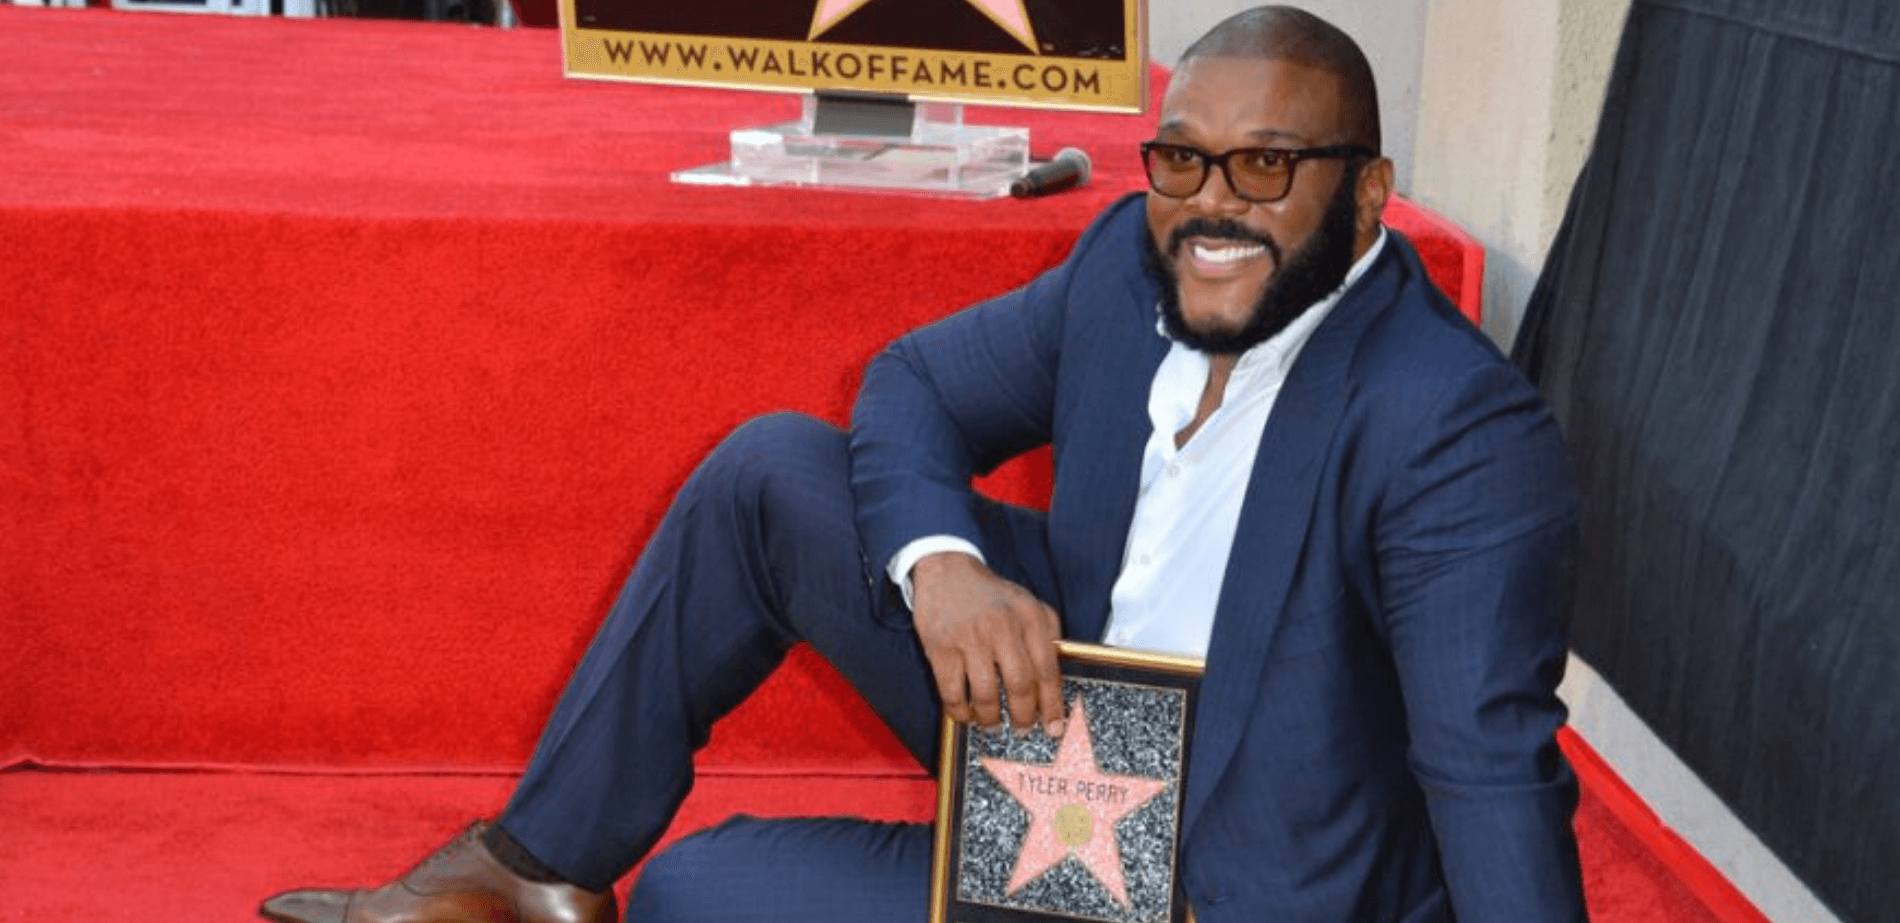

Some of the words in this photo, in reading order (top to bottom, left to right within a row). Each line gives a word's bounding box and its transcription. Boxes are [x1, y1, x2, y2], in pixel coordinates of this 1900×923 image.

[603, 39, 1101, 94] WWW.WALKOFFAME.COM
[1018, 773, 1067, 796] TYLER
[1076, 780, 1129, 803] PERRY
